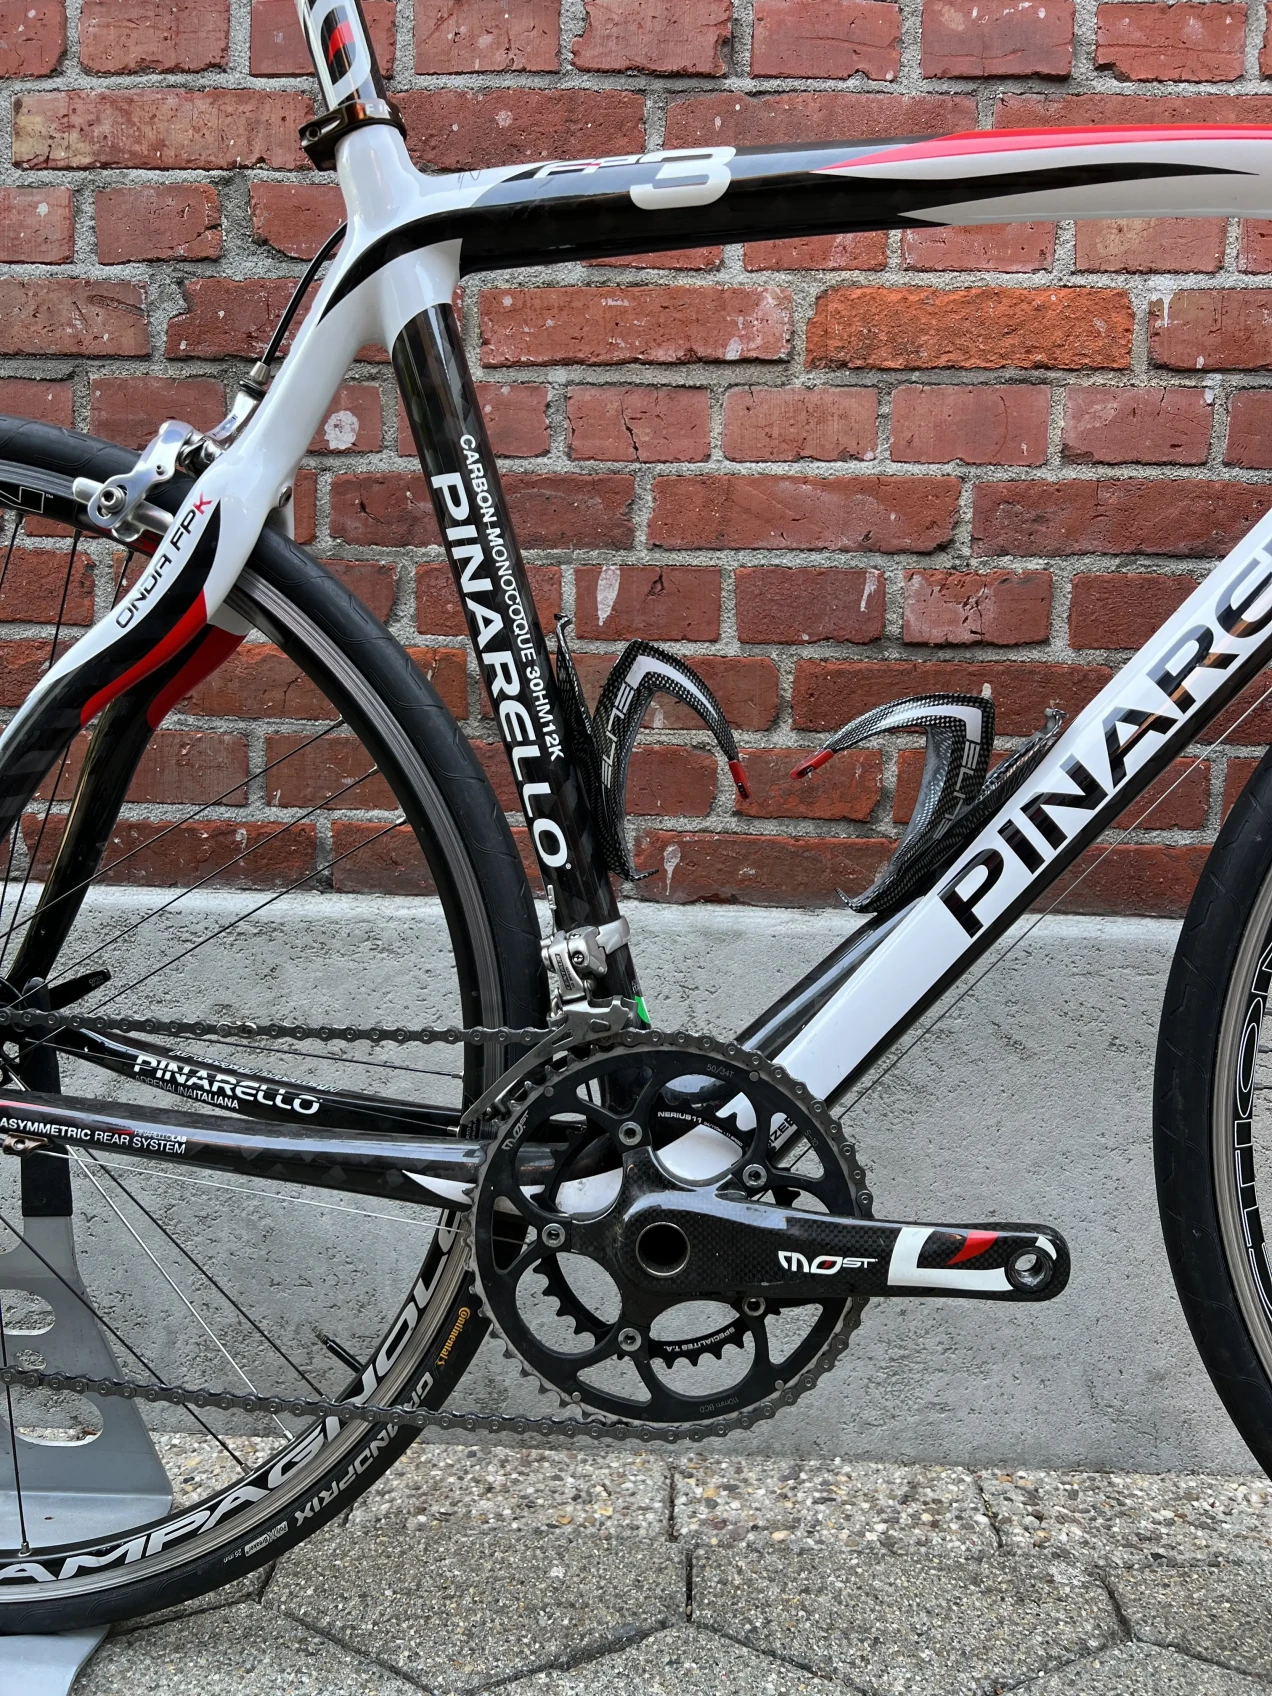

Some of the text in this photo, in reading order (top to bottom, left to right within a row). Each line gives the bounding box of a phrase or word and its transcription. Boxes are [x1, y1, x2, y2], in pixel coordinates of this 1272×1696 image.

[115, 491, 213, 629] ONDA FPK
[460, 434, 565, 762] CARBON MONOCOQUE 30HM12K
[133, 1054, 321, 1115] PINARELLO
[706, 1063, 735, 1079] 50/34T
[0, 1117, 187, 1155] ASYMMETRIC REAR SYSTEM
[440, 1306, 472, 1358] Continental
